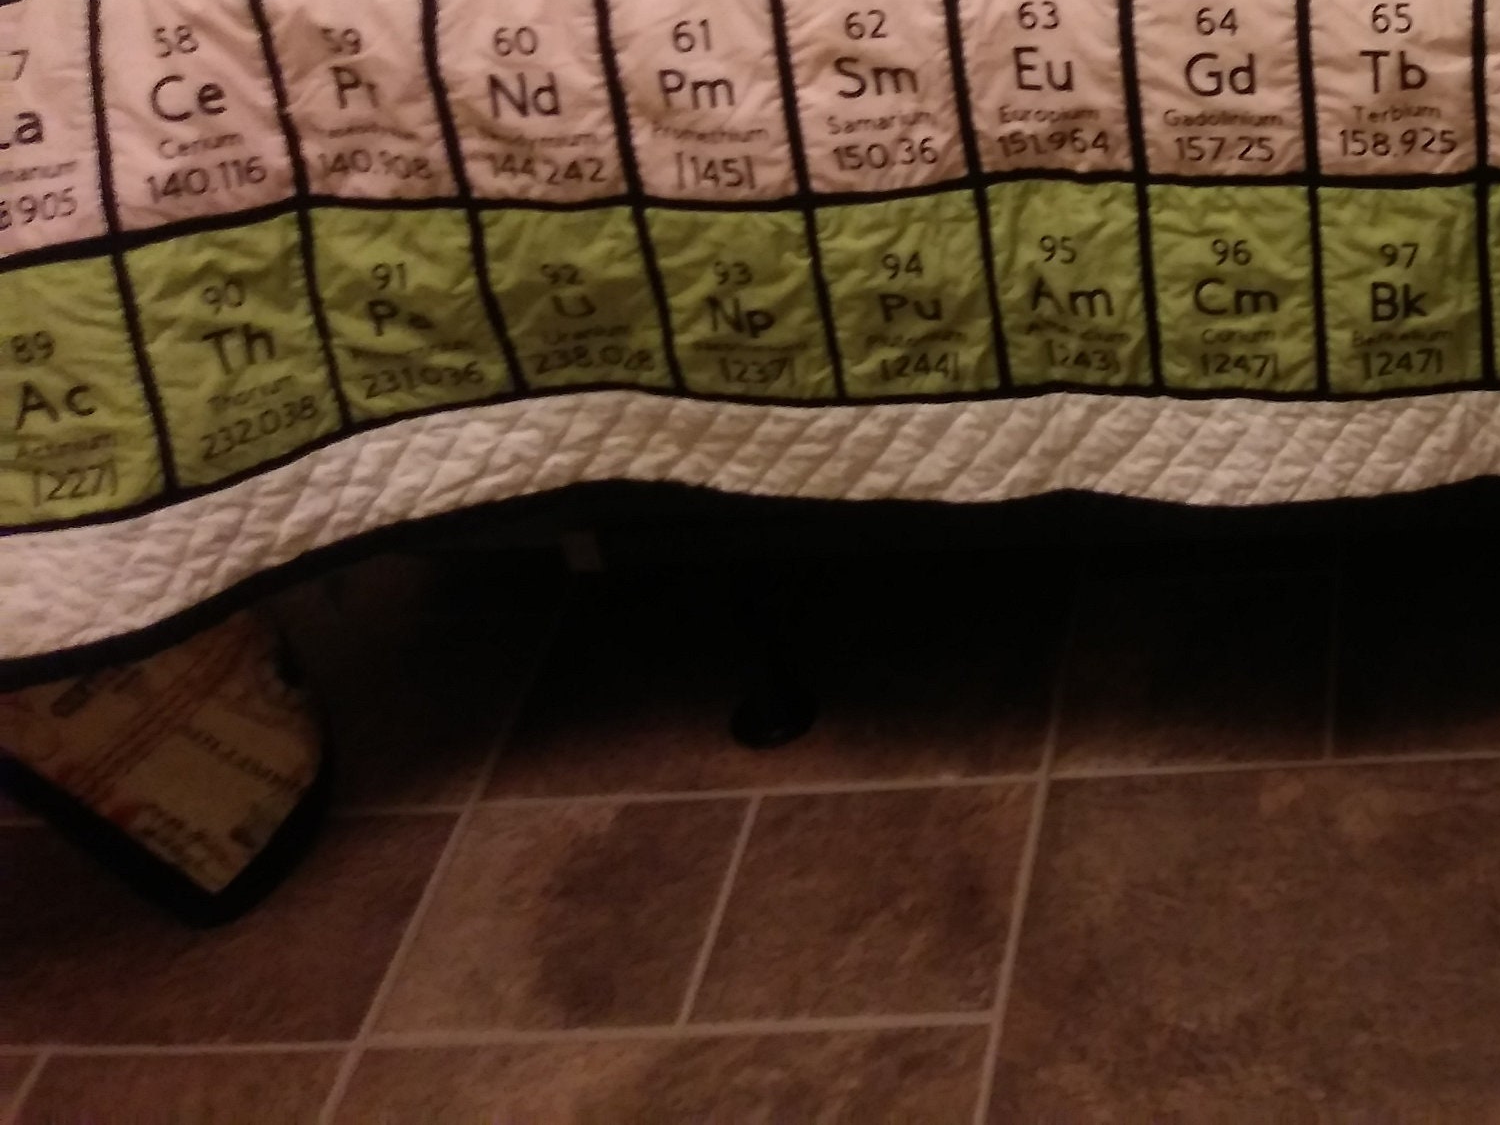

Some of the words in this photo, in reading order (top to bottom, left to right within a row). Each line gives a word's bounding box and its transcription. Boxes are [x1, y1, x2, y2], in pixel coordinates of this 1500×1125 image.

[844, 9, 888, 40] 62
[1017, 1, 1060, 30] 63
[1196, 7, 1239, 36] 64
[1371, 2, 1413, 34] 65
[152, 25, 200, 58] 58
[494, 26, 539, 57] 60
[671, 19, 713, 53] 61
[834, 56, 919, 99] Sm
[1012, 46, 1075, 92] Eu
[1184, 51, 1257, 97] Gd
[1359, 50, 1429, 94] Tb
[151, 74, 228, 123] Ce
[486, 71, 561, 118] Nd
[658, 69, 736, 110] Pm
[1339, 128, 1458, 158] 158.925
[675, 151, 757, 192] [145]
[879, 251, 925, 280] 94
[1039, 235, 1078, 264] 95
[1211, 238, 1252, 265] 96
[1379, 243, 1419, 268] 97
[371, 262, 407, 290] 91
[202, 278, 246, 315] 90
[877, 293, 945, 322] Pu
[1030, 276, 1113, 318] Am
[1193, 277, 1279, 315] Cm
[1370, 281, 1428, 322] Bk
[703, 294, 777, 338] Np
[201, 323, 275, 376] Th
[15, 381, 96, 431] Ac
